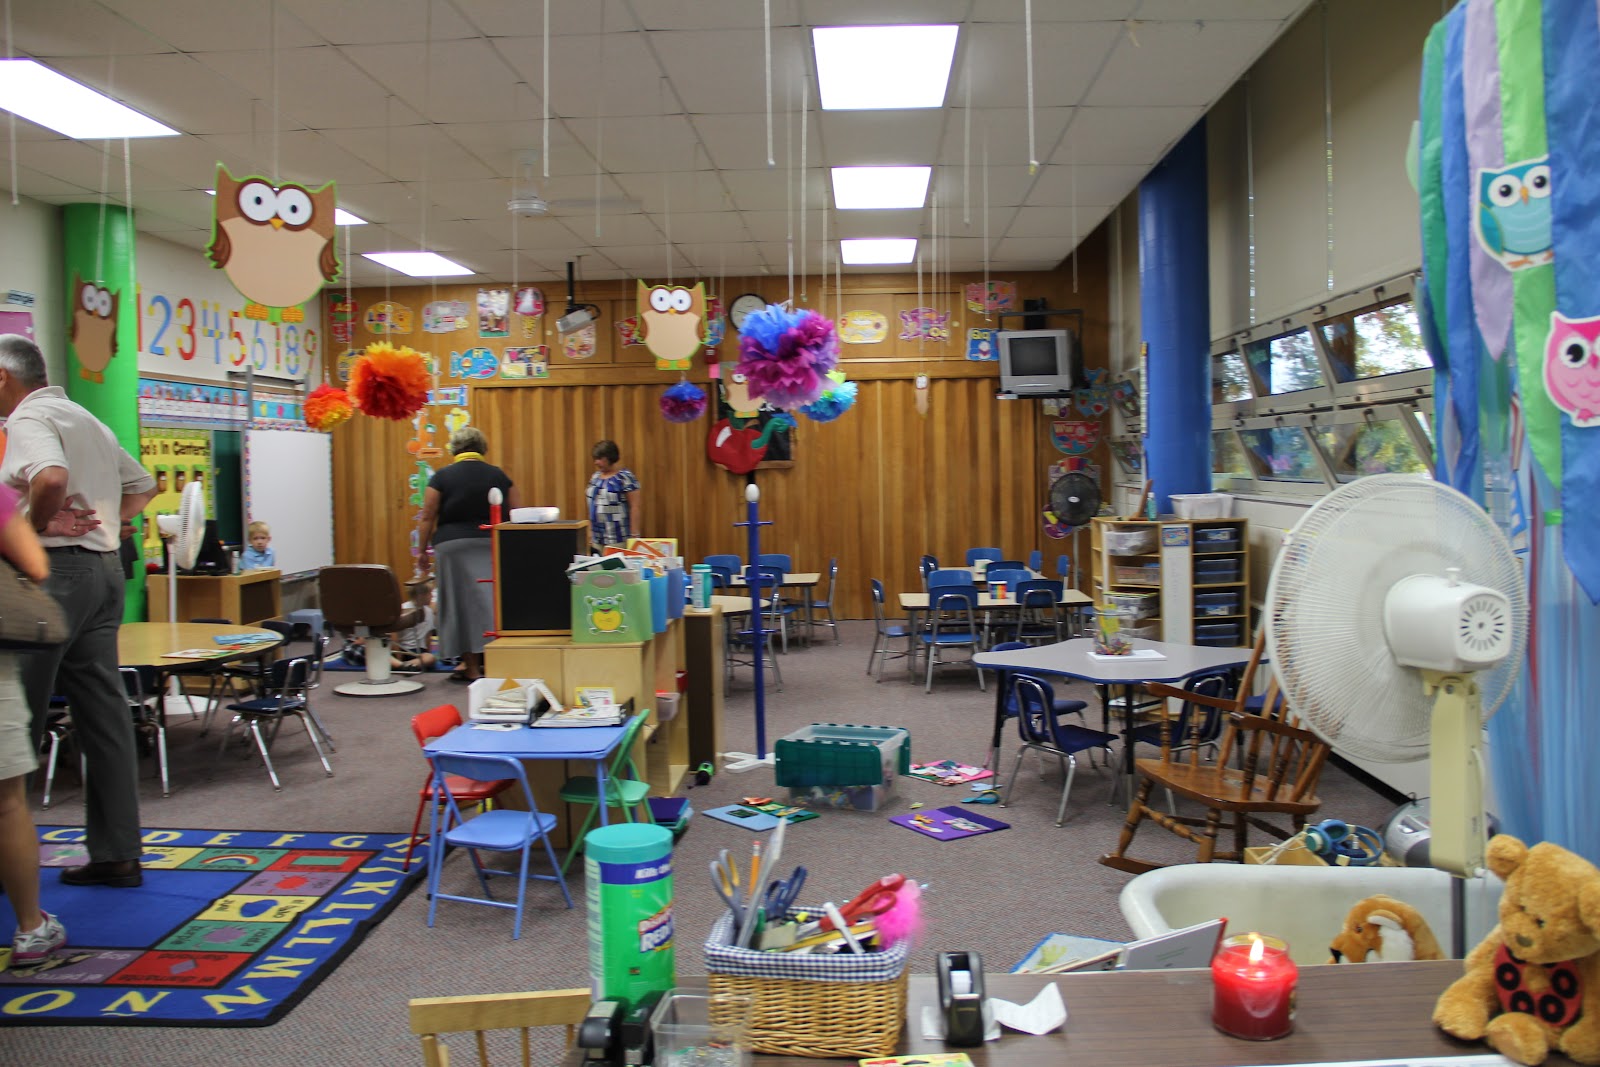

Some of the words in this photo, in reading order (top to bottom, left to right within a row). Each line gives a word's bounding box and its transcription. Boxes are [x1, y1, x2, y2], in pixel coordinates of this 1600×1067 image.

[148, 295, 172, 356] 2
[176, 298, 196, 360] 3
[202, 300, 224, 364] 4
[229, 310, 246, 366] 5
[251, 319, 267, 370] 6
[285, 325, 299, 375] 8
[304, 329, 317, 374] 9
[141, 830, 183, 844] D
[203, 833, 241, 845] E
[267, 834, 306, 847] F
[329, 835, 368, 848] G
[2, 989, 76, 1015] O
